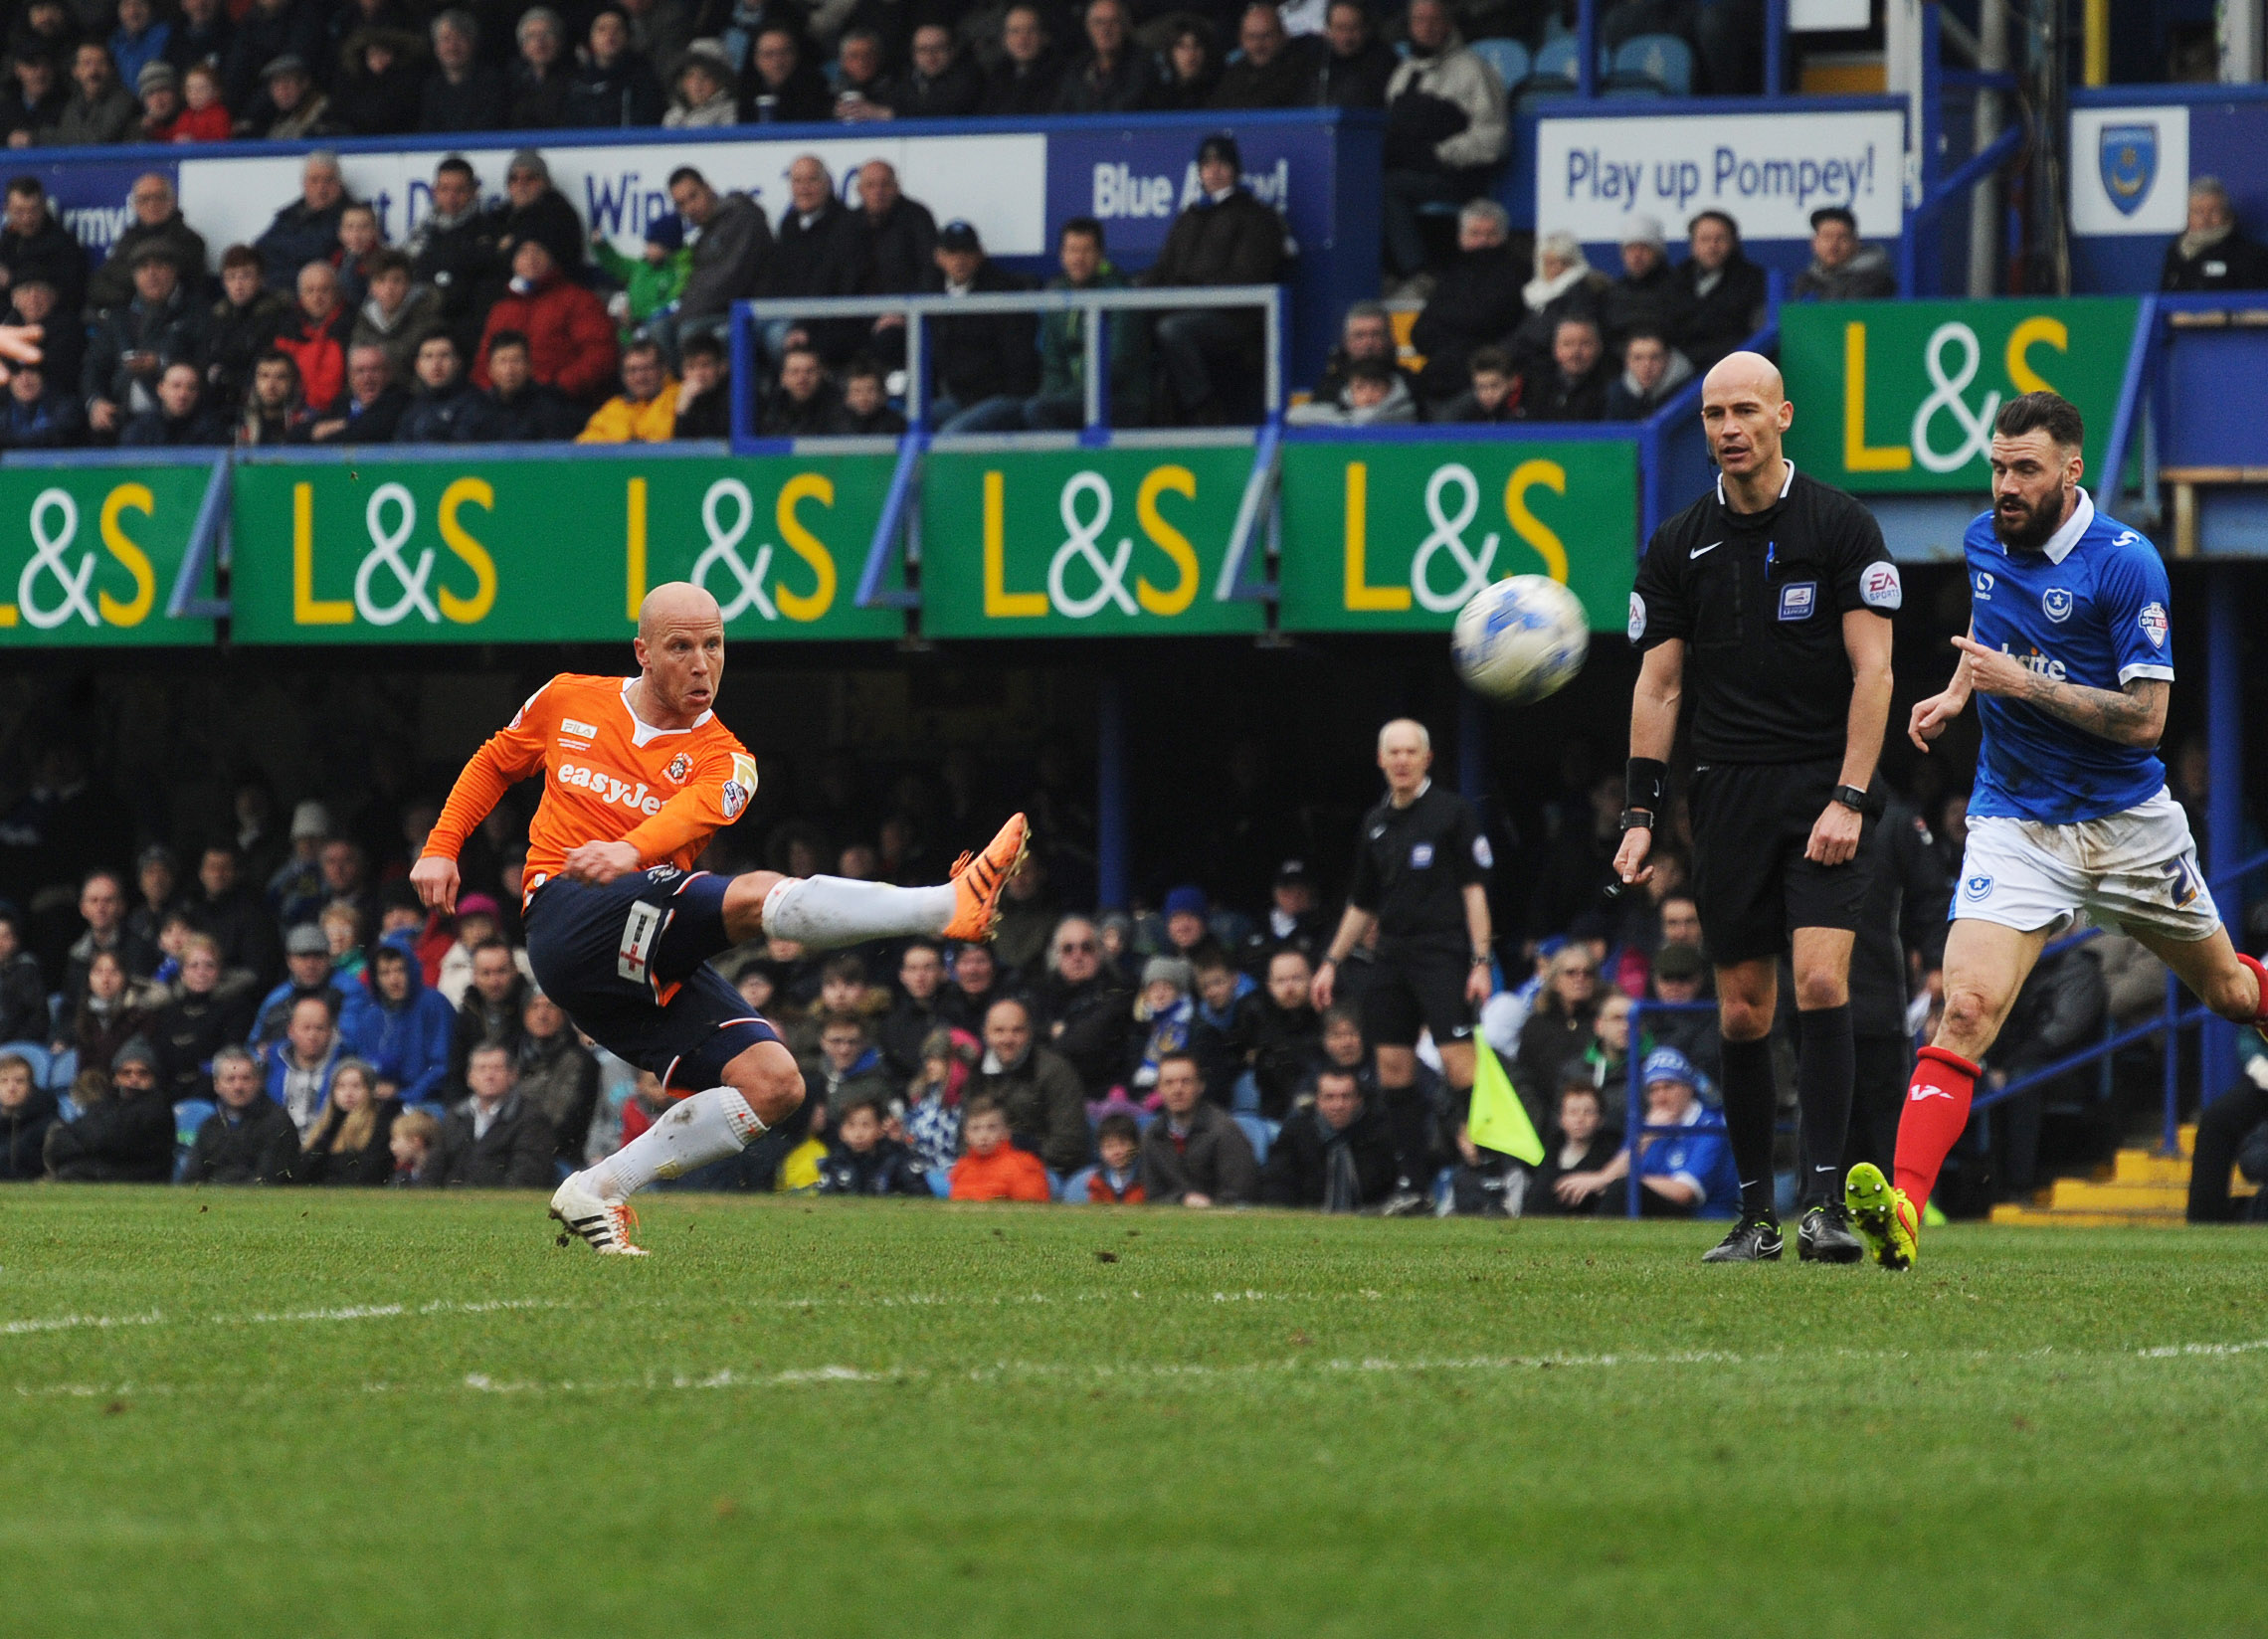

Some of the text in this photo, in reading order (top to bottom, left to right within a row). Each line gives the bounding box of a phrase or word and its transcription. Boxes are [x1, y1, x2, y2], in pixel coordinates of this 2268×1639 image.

[1093, 162, 1174, 218] Blue
[1567, 143, 1875, 212] Play up Pompey!
[293, 476, 496, 626] L&S
[984, 464, 1200, 618] L&S
[1345, 458, 1569, 613] L&S
[1870, 573, 1898, 592] EA
[1870, 589, 1900, 601] SPORTS
[564, 722, 592, 737] FILA
